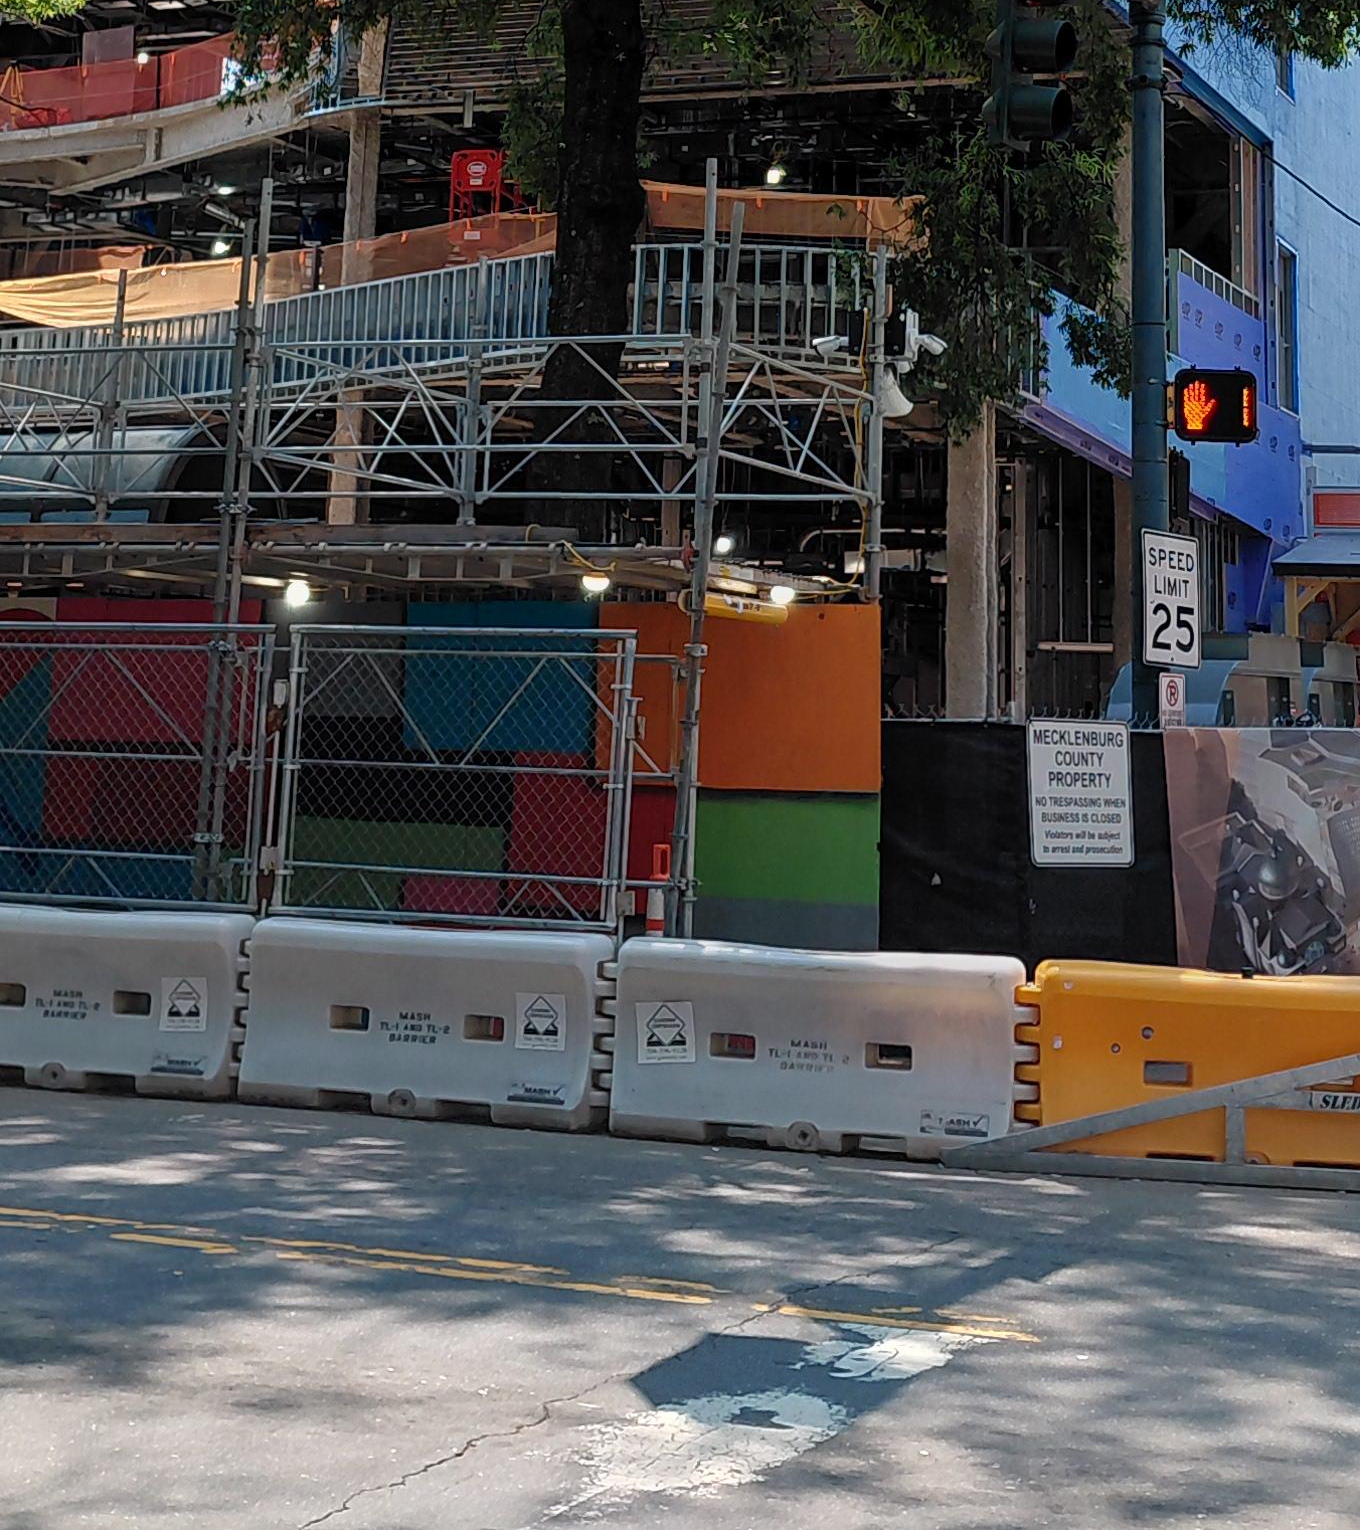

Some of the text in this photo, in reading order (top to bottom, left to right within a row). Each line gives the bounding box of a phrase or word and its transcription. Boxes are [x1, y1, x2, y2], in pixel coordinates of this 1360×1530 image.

[1148, 546, 1195, 573] SPEED
[1154, 574, 1190, 599] LIMIT
[1151, 602, 1195, 653] 25
[1033, 729, 1124, 748] MECKLENBURG
[1055, 750, 1105, 767] COUNTY
[1048, 771, 1112, 789] PROPERTY
[1035, 796, 1126, 809] NO TRESPASSING WHEN
[1041, 812, 1122, 824] BUSINESS IS CLOSED
[1044, 830, 1121, 842] Violators will be subject
[1051, 845, 1070, 854] arrest
[1072, 845, 1084, 854] and
[1085, 845, 1123, 856] prosecution
[399, 1012, 431, 1022] MASH
[389, 1032, 437, 1044] BARRIER
[790, 1039, 828, 1050] MASH
